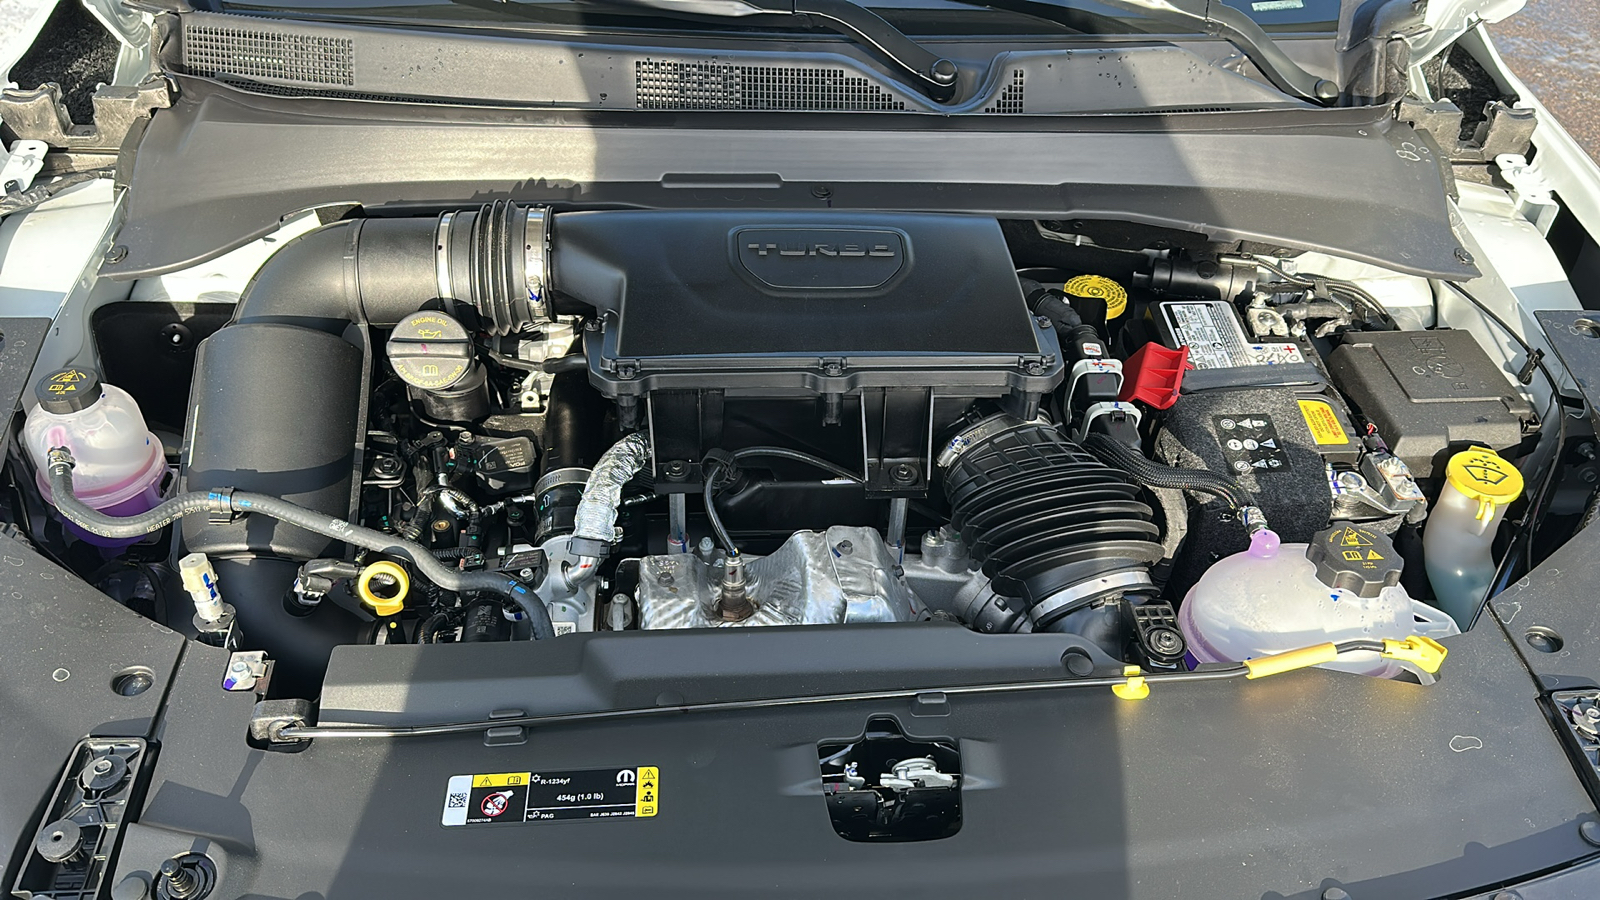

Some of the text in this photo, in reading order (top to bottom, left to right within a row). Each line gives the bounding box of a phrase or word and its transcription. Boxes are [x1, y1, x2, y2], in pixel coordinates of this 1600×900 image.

[748, 243, 895, 257] TURBO
[411, 316, 448, 327] ENGINE OIL
[146, 517, 171, 533] HEATER
[556, 792, 604, 802] 454g (1.0 lb)
